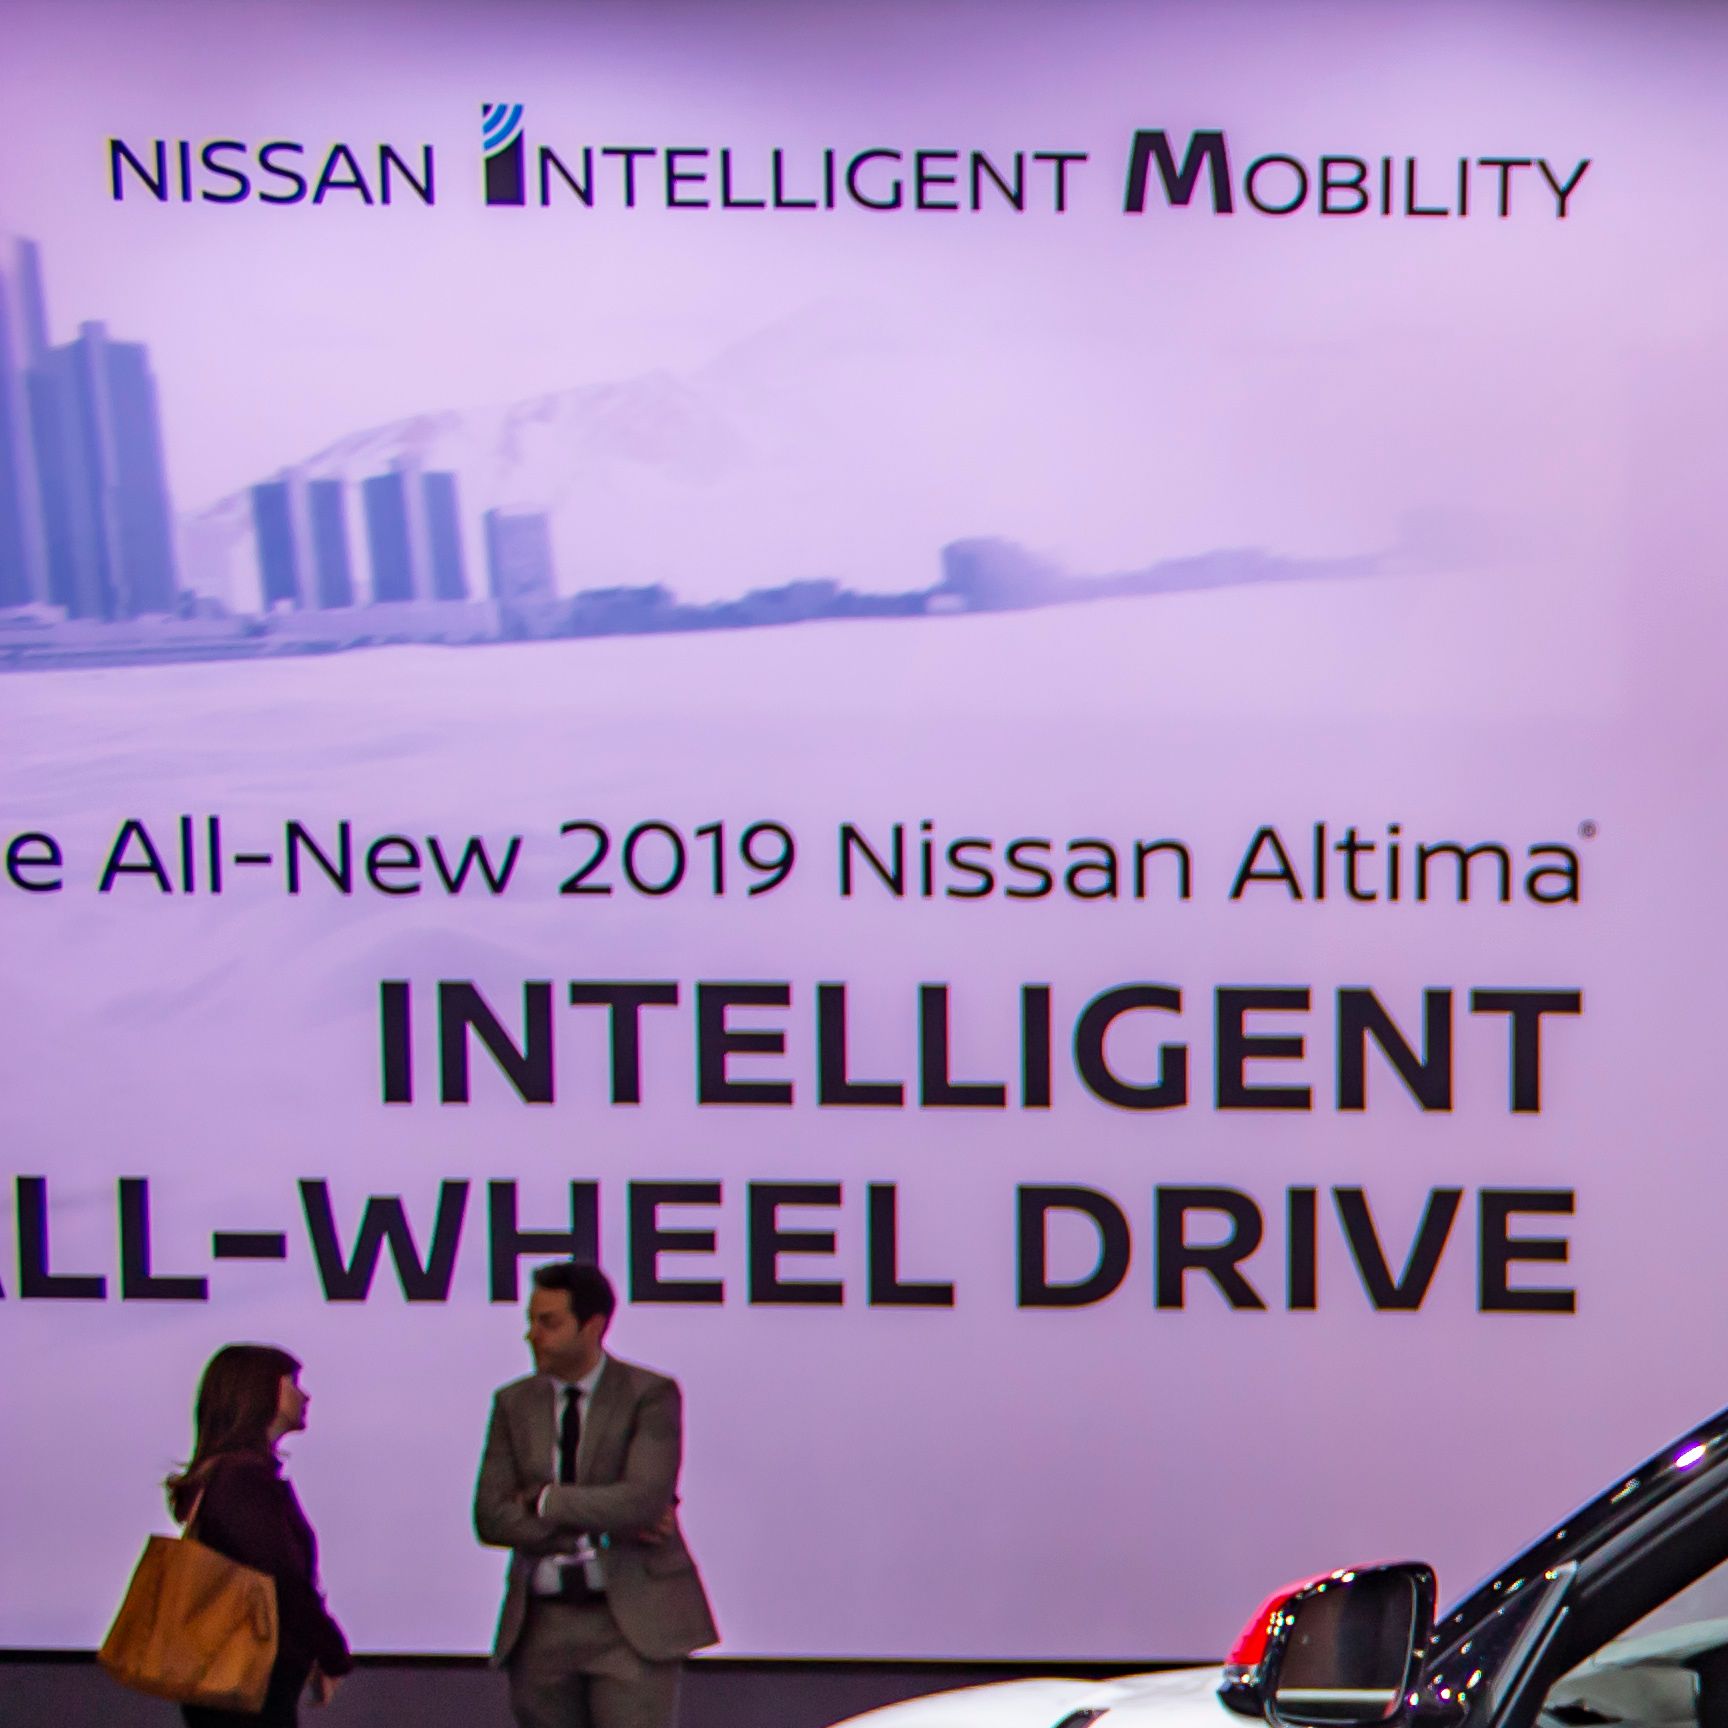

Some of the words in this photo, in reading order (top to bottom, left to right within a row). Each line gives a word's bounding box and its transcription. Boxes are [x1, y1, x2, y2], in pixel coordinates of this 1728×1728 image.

[110, 138, 436, 207] NISSAN
[482, 104, 1089, 212] INTELLIGENT
[1123, 129, 1592, 219] MOBILITY
[98, 815, 523, 896] All-New
[559, 821, 796, 896] 2019
[840, 821, 1192, 900] Nissan
[380, 981, 1582, 1114] INTELLIGENT
[0, 1176, 955, 1306] LL-WHEEL
[1017, 1185, 1577, 1314] DRIVE
